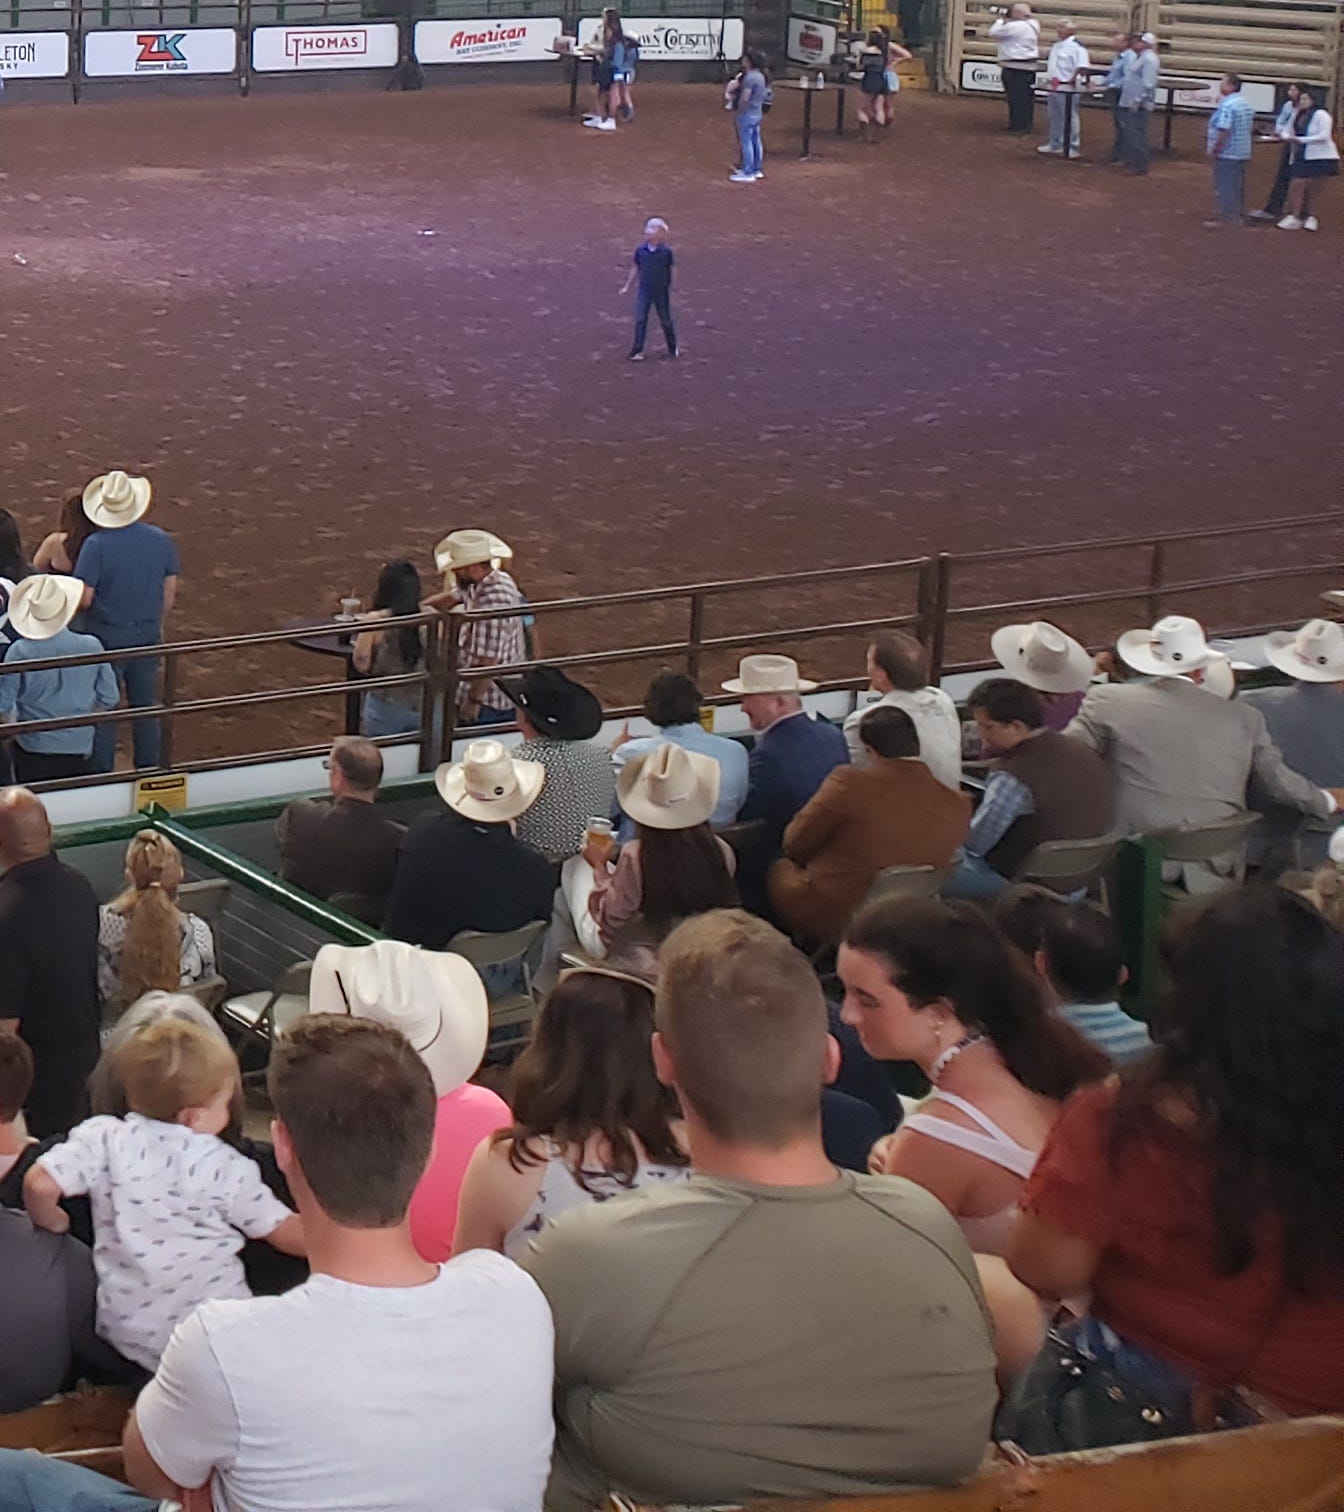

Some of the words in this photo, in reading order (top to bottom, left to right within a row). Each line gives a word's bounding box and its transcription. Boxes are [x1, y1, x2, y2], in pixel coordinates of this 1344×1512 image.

[136, 34, 188, 61] ZK
[450, 26, 526, 48] American
[292, 37, 358, 66] THOMAS
